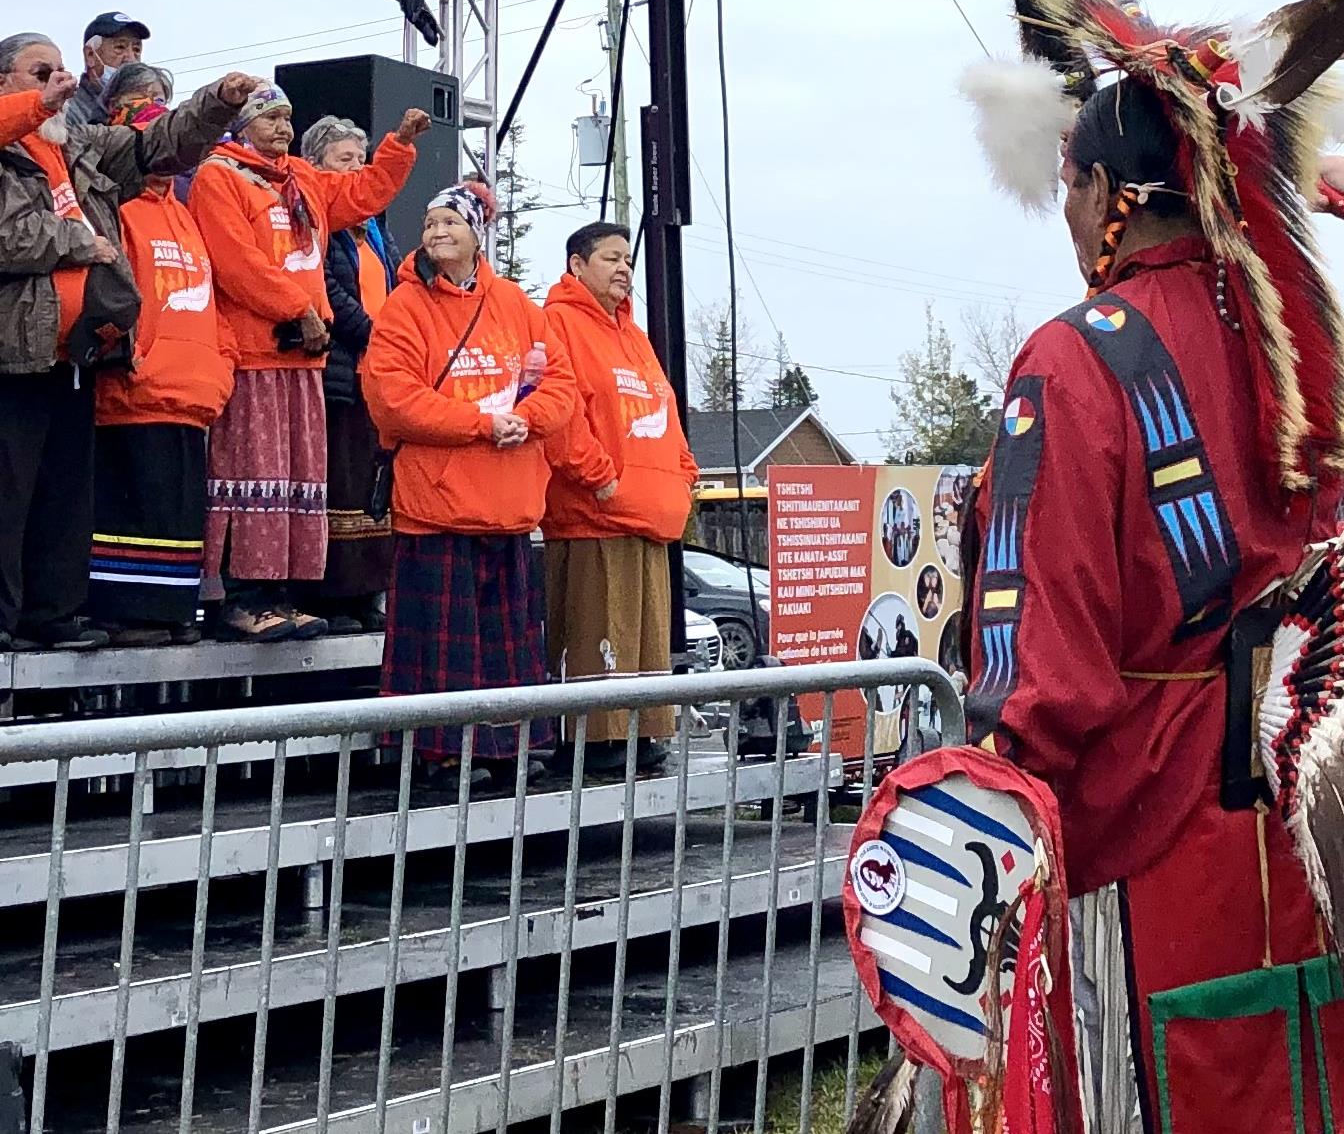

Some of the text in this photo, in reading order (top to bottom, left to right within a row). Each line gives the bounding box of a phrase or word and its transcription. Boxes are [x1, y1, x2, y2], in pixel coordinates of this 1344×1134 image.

[776, 483, 813, 495] TSHETSHI
[777, 518, 789, 529] NE
[830, 517, 841, 528] UA
[777, 550, 848, 563] UTE KANATA-ASSIT
[778, 568, 814, 581] TSHETSHI
[850, 566, 866, 578] MAK
[778, 586, 795, 598] KAU
[778, 602, 811, 616] TAKUAKI
[777, 628, 844, 644] Pour que la journée
[811, 646, 819, 657] de
[821, 645, 827, 656] la
[828, 643, 847, 655] vérité
